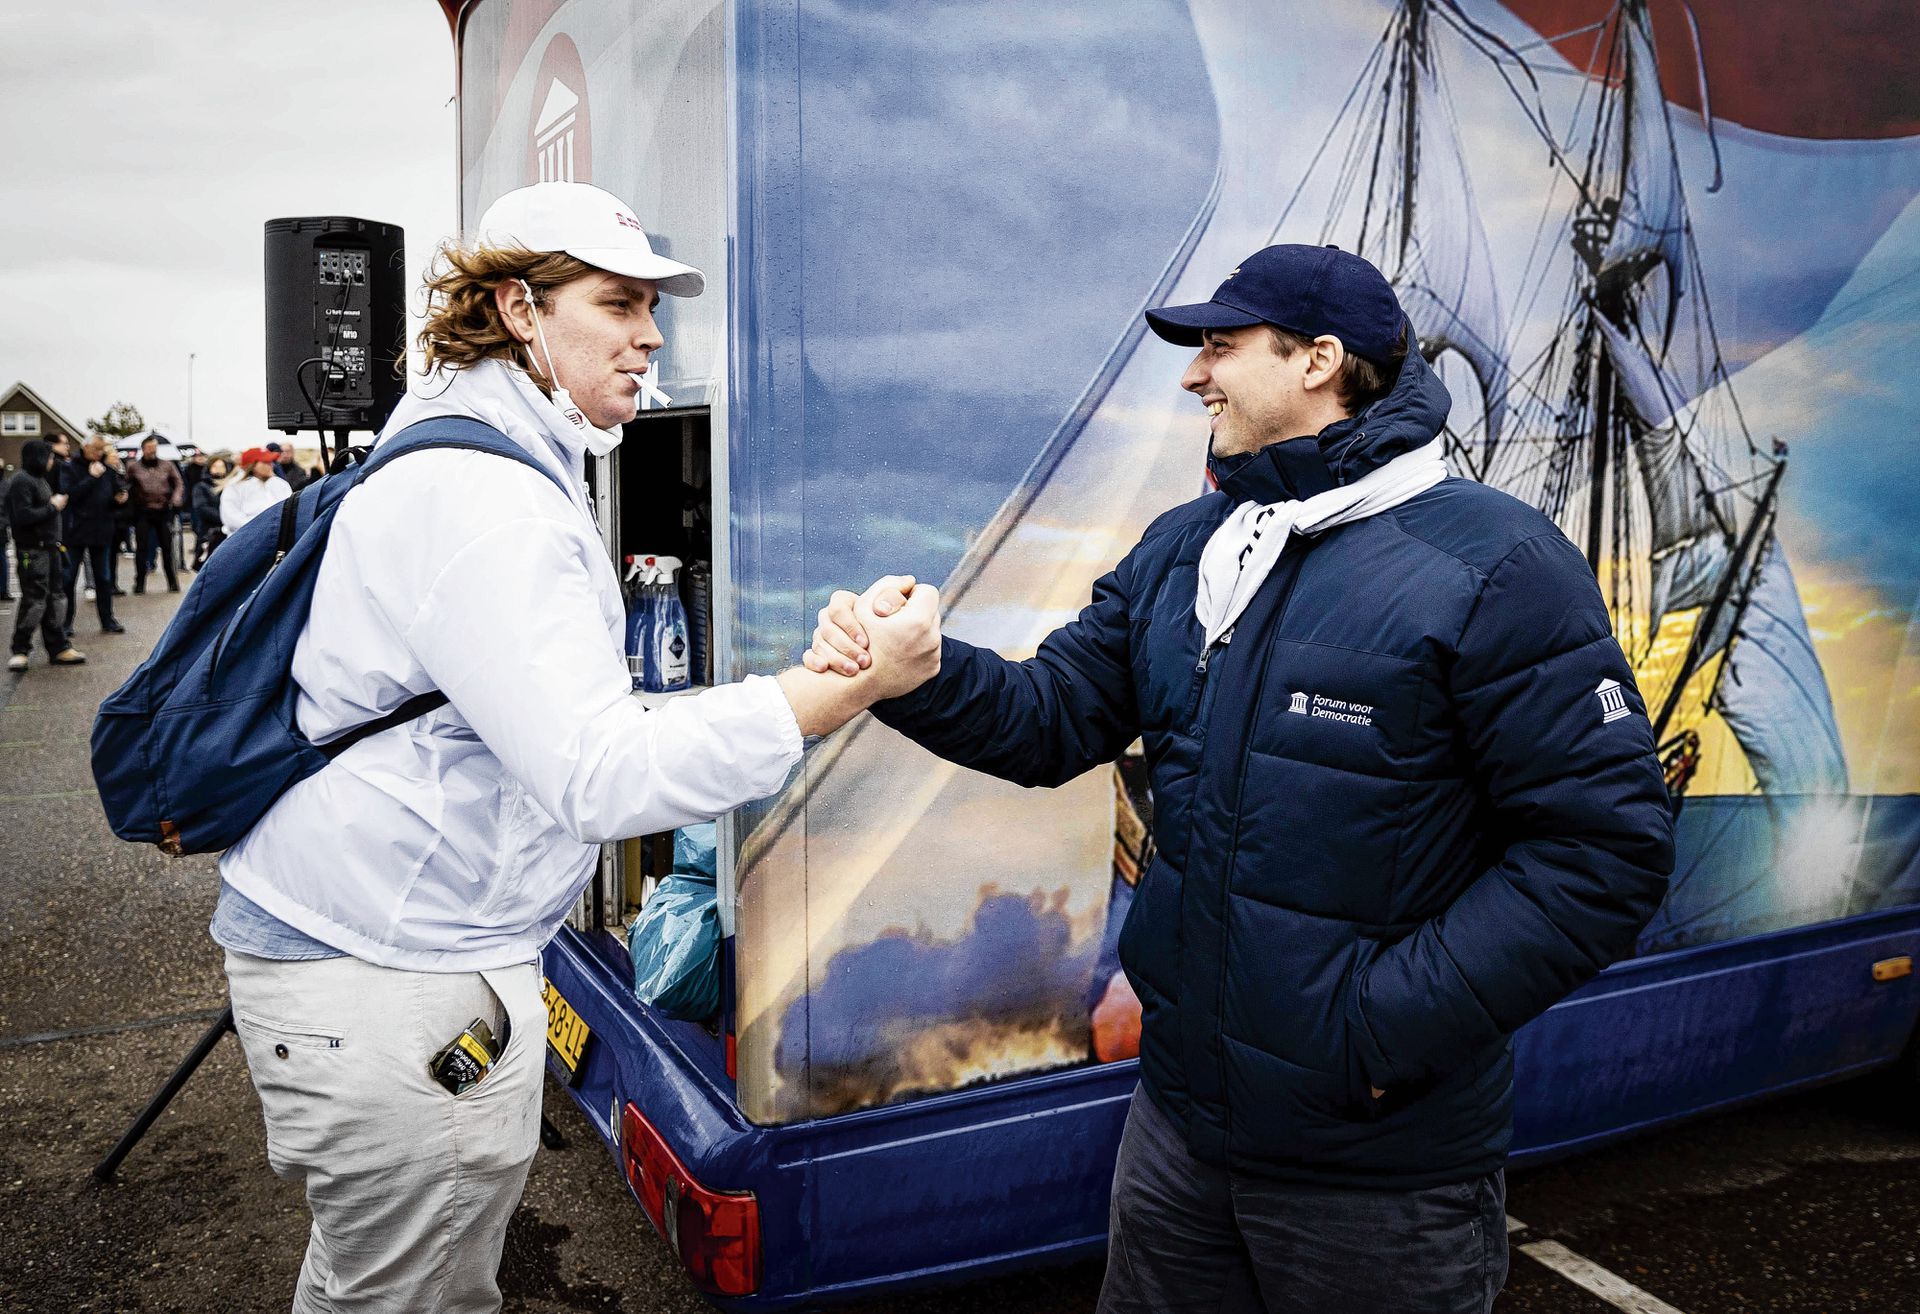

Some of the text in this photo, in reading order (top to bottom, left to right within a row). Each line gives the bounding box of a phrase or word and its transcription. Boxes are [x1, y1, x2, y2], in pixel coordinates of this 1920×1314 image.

[1313, 694, 1374, 714] Forum voor
[1311, 706, 1372, 726] Democratie
